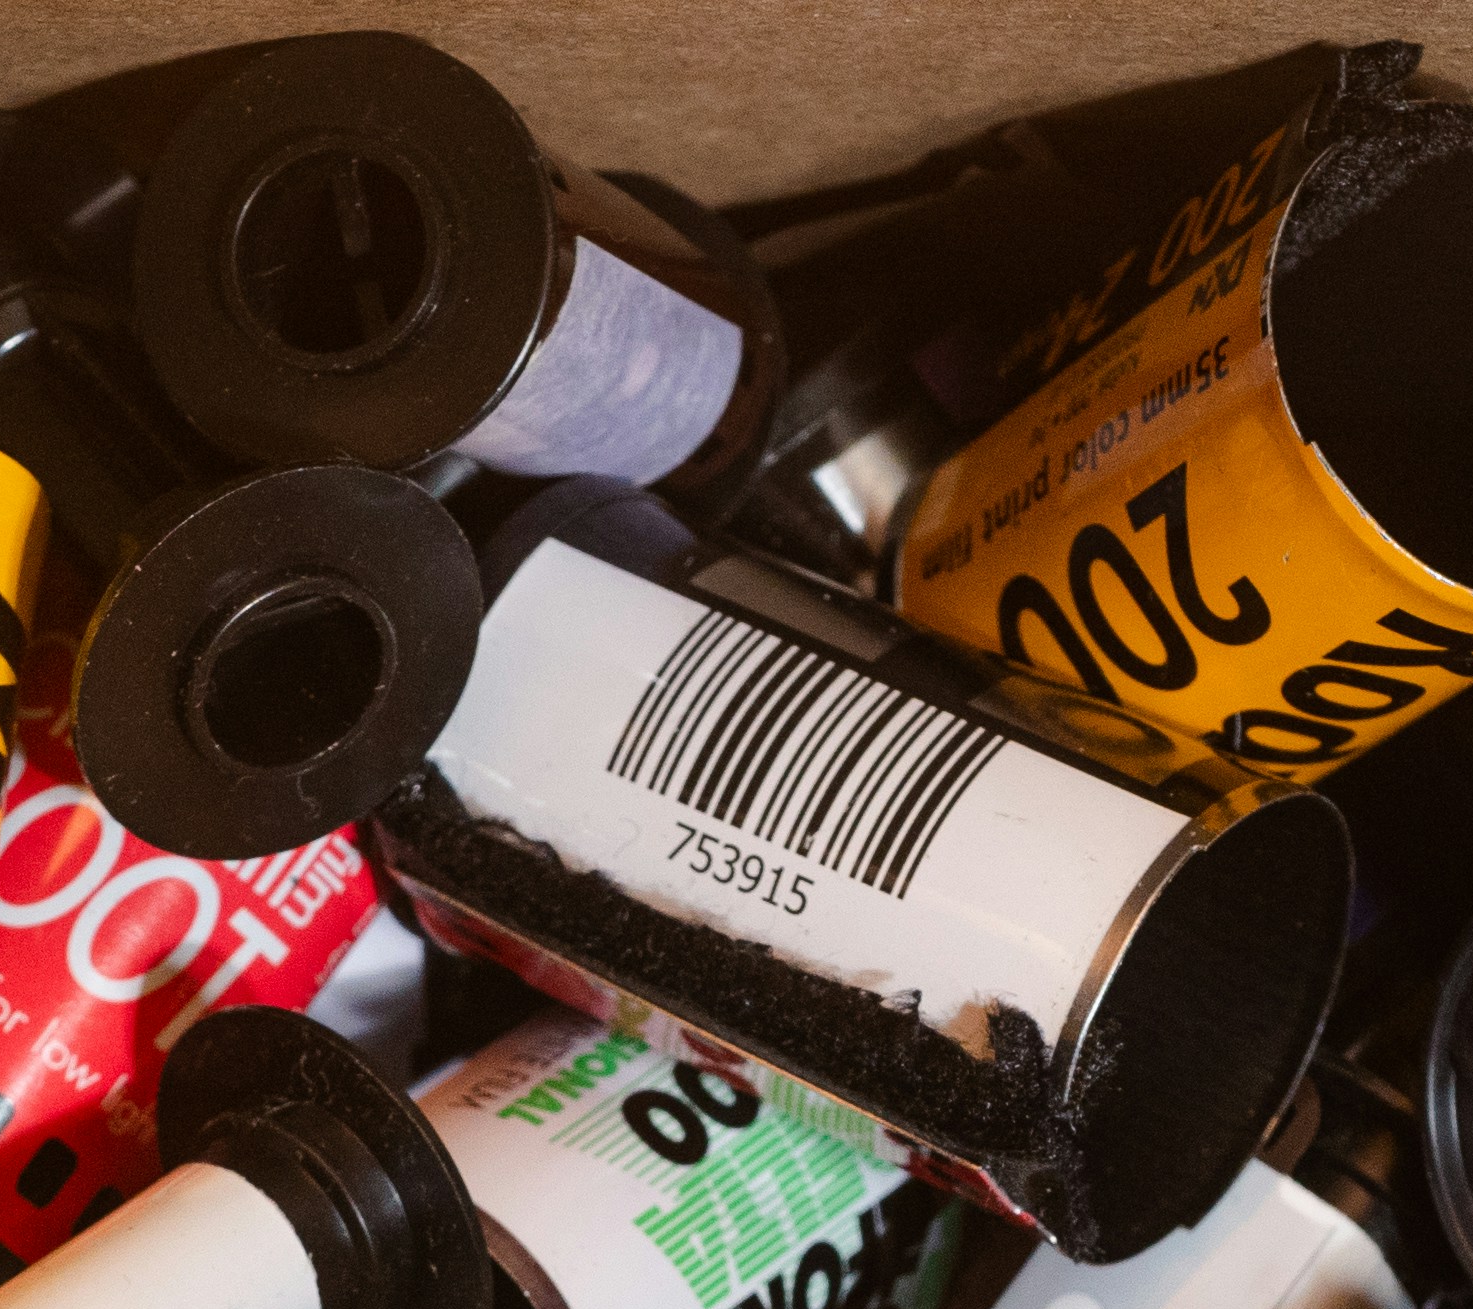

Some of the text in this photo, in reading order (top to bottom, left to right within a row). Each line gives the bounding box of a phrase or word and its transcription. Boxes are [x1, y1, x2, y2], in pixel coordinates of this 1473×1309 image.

[1060, 410, 1130, 485] color
[664, 821, 815, 915] 753915
[31, 1018, 103, 1092] low
